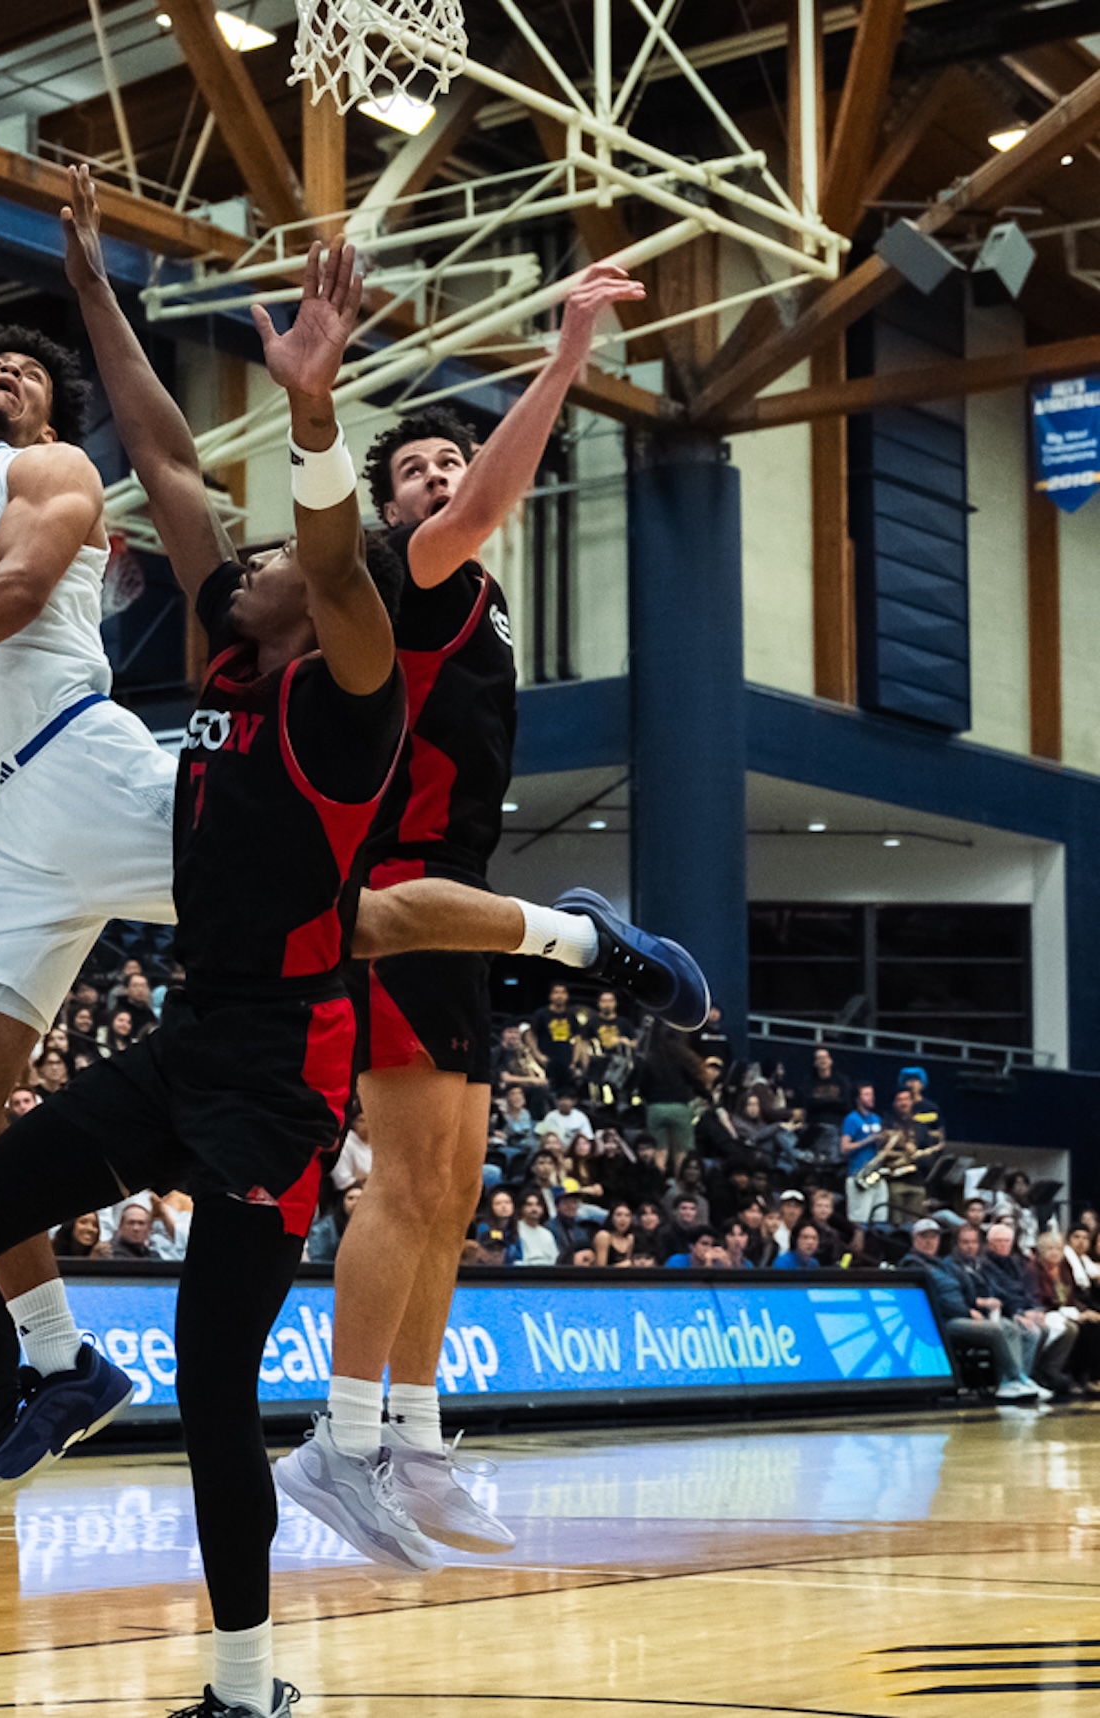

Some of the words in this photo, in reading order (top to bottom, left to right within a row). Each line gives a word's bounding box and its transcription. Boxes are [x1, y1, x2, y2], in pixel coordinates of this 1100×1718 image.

[436, 1324, 499, 1392] pp
[522, 1310, 621, 1373] Now
[634, 1308, 802, 1371] Available
